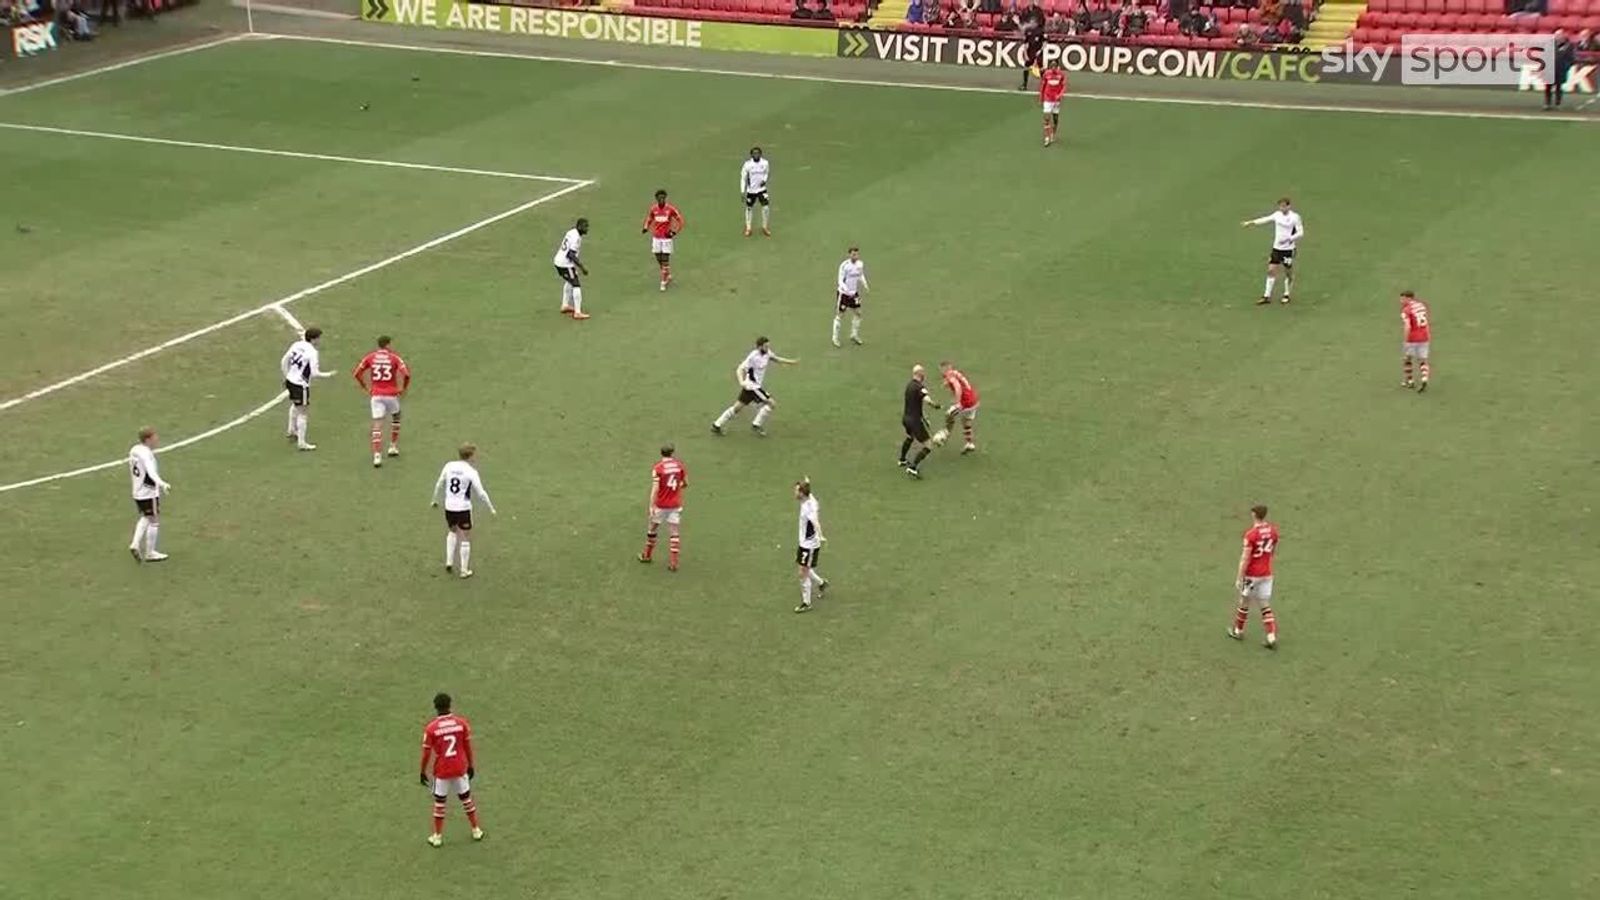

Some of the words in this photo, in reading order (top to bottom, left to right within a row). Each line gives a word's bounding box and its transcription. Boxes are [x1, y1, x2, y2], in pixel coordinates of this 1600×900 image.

[393, 0, 436, 25] WE
[446, 2, 501, 31] ARE
[510, 7, 703, 48] RESPONSIBLE
[873, 33, 949, 63] VISIT
[1519, 63, 1597, 93] RK
[371, 363, 393, 381] 33
[449, 476, 461, 495] 8
[666, 473, 678, 491] 4
[443, 735, 458, 758] 2
